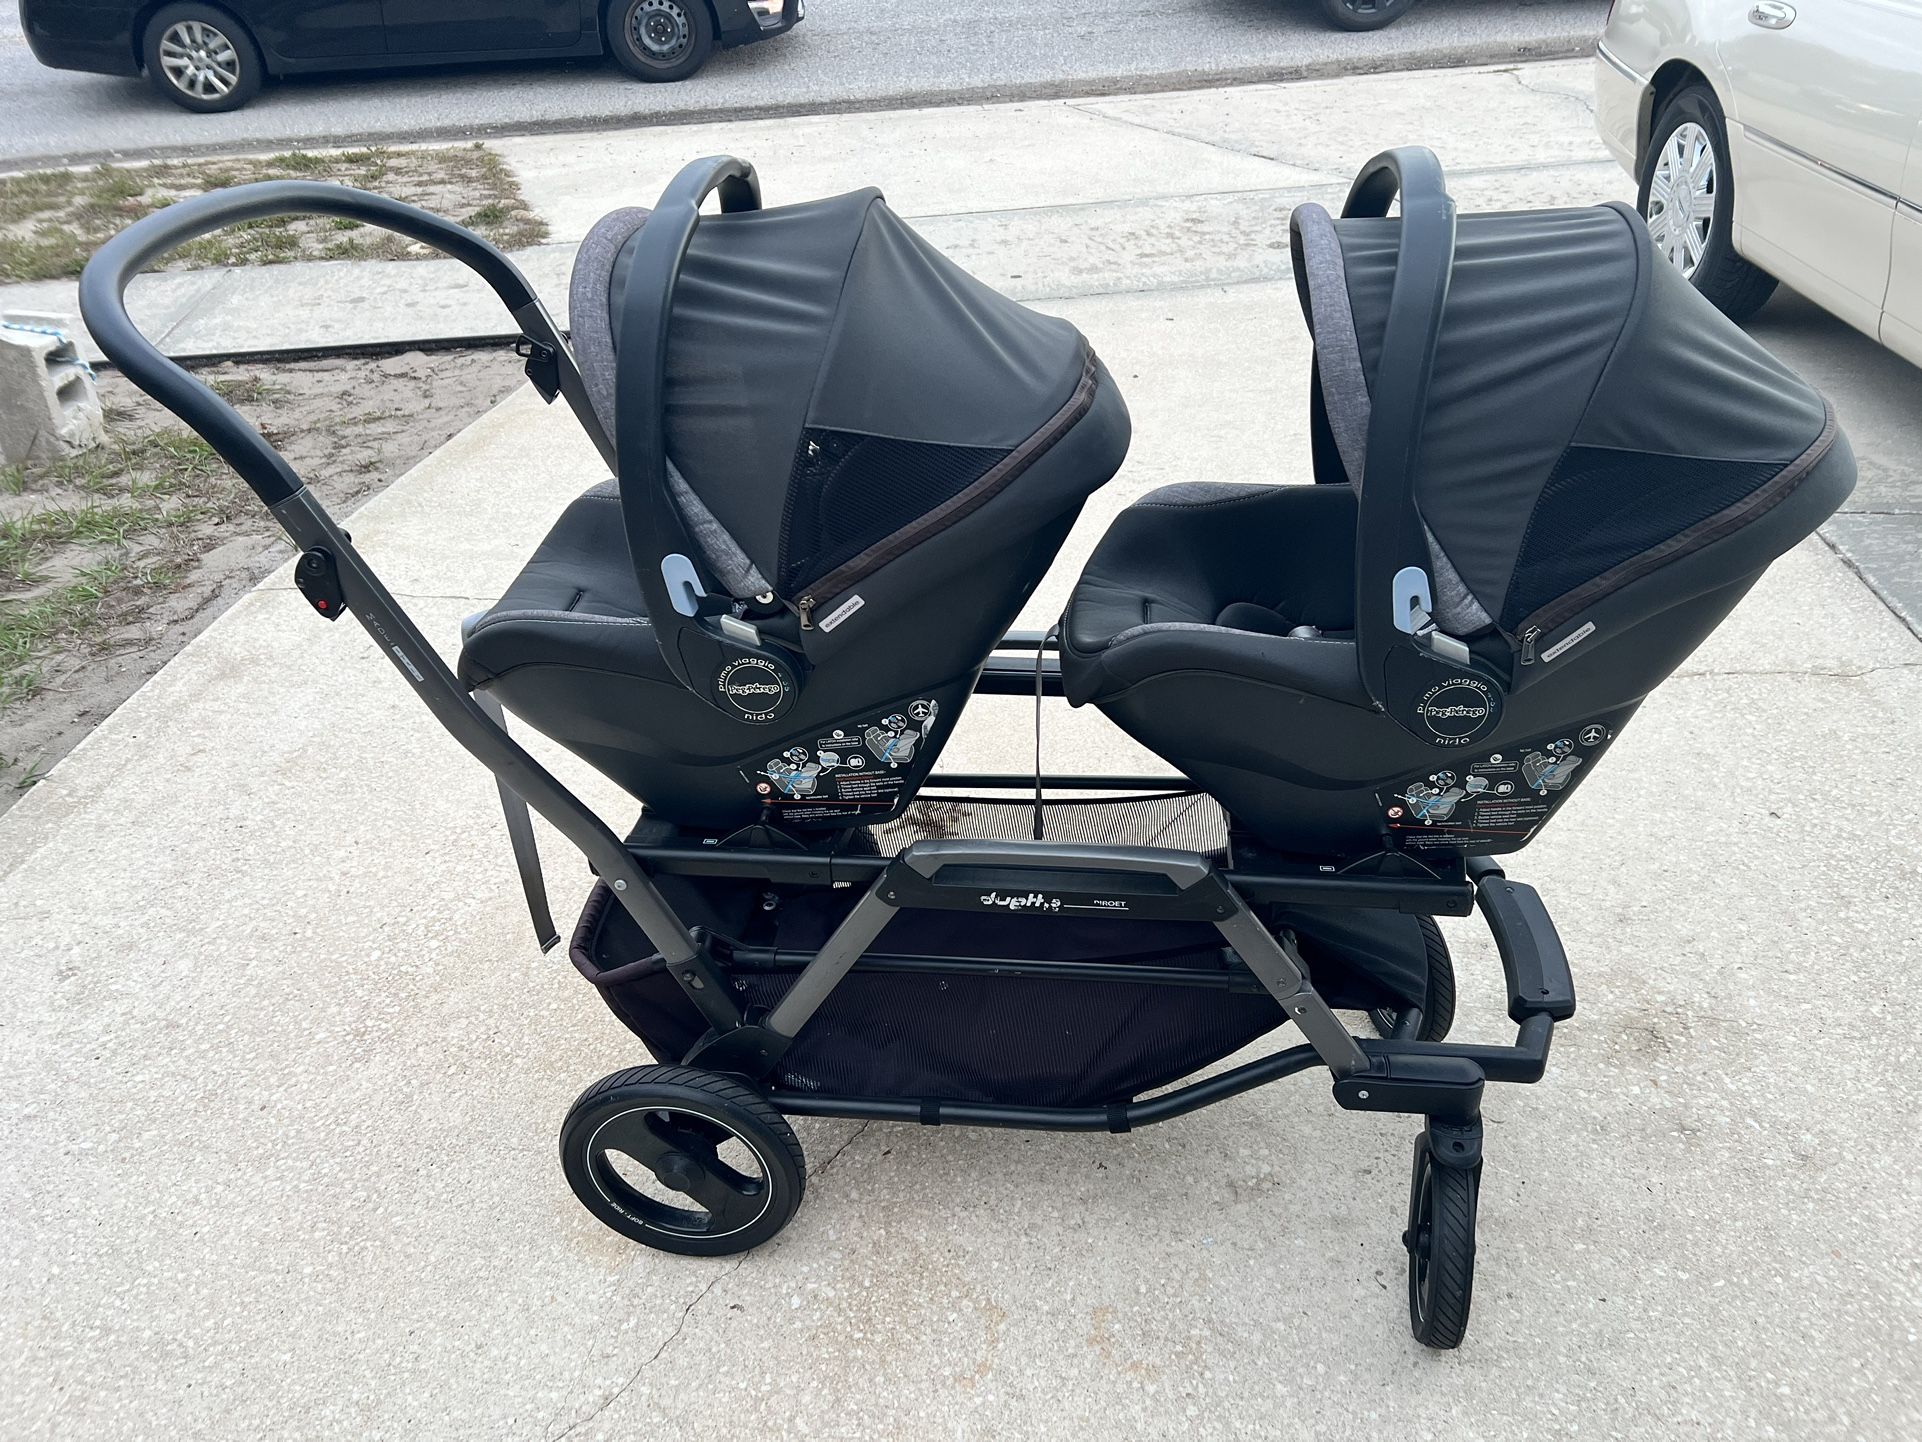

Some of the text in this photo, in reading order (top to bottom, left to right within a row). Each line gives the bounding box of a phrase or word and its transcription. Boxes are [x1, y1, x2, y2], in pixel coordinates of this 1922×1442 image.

[824, 600, 860, 629] extendable
[717, 657, 775, 692] primo viaggio
[1416, 678, 1488, 713] pmo viaggio
[744, 712, 775, 721] nido
